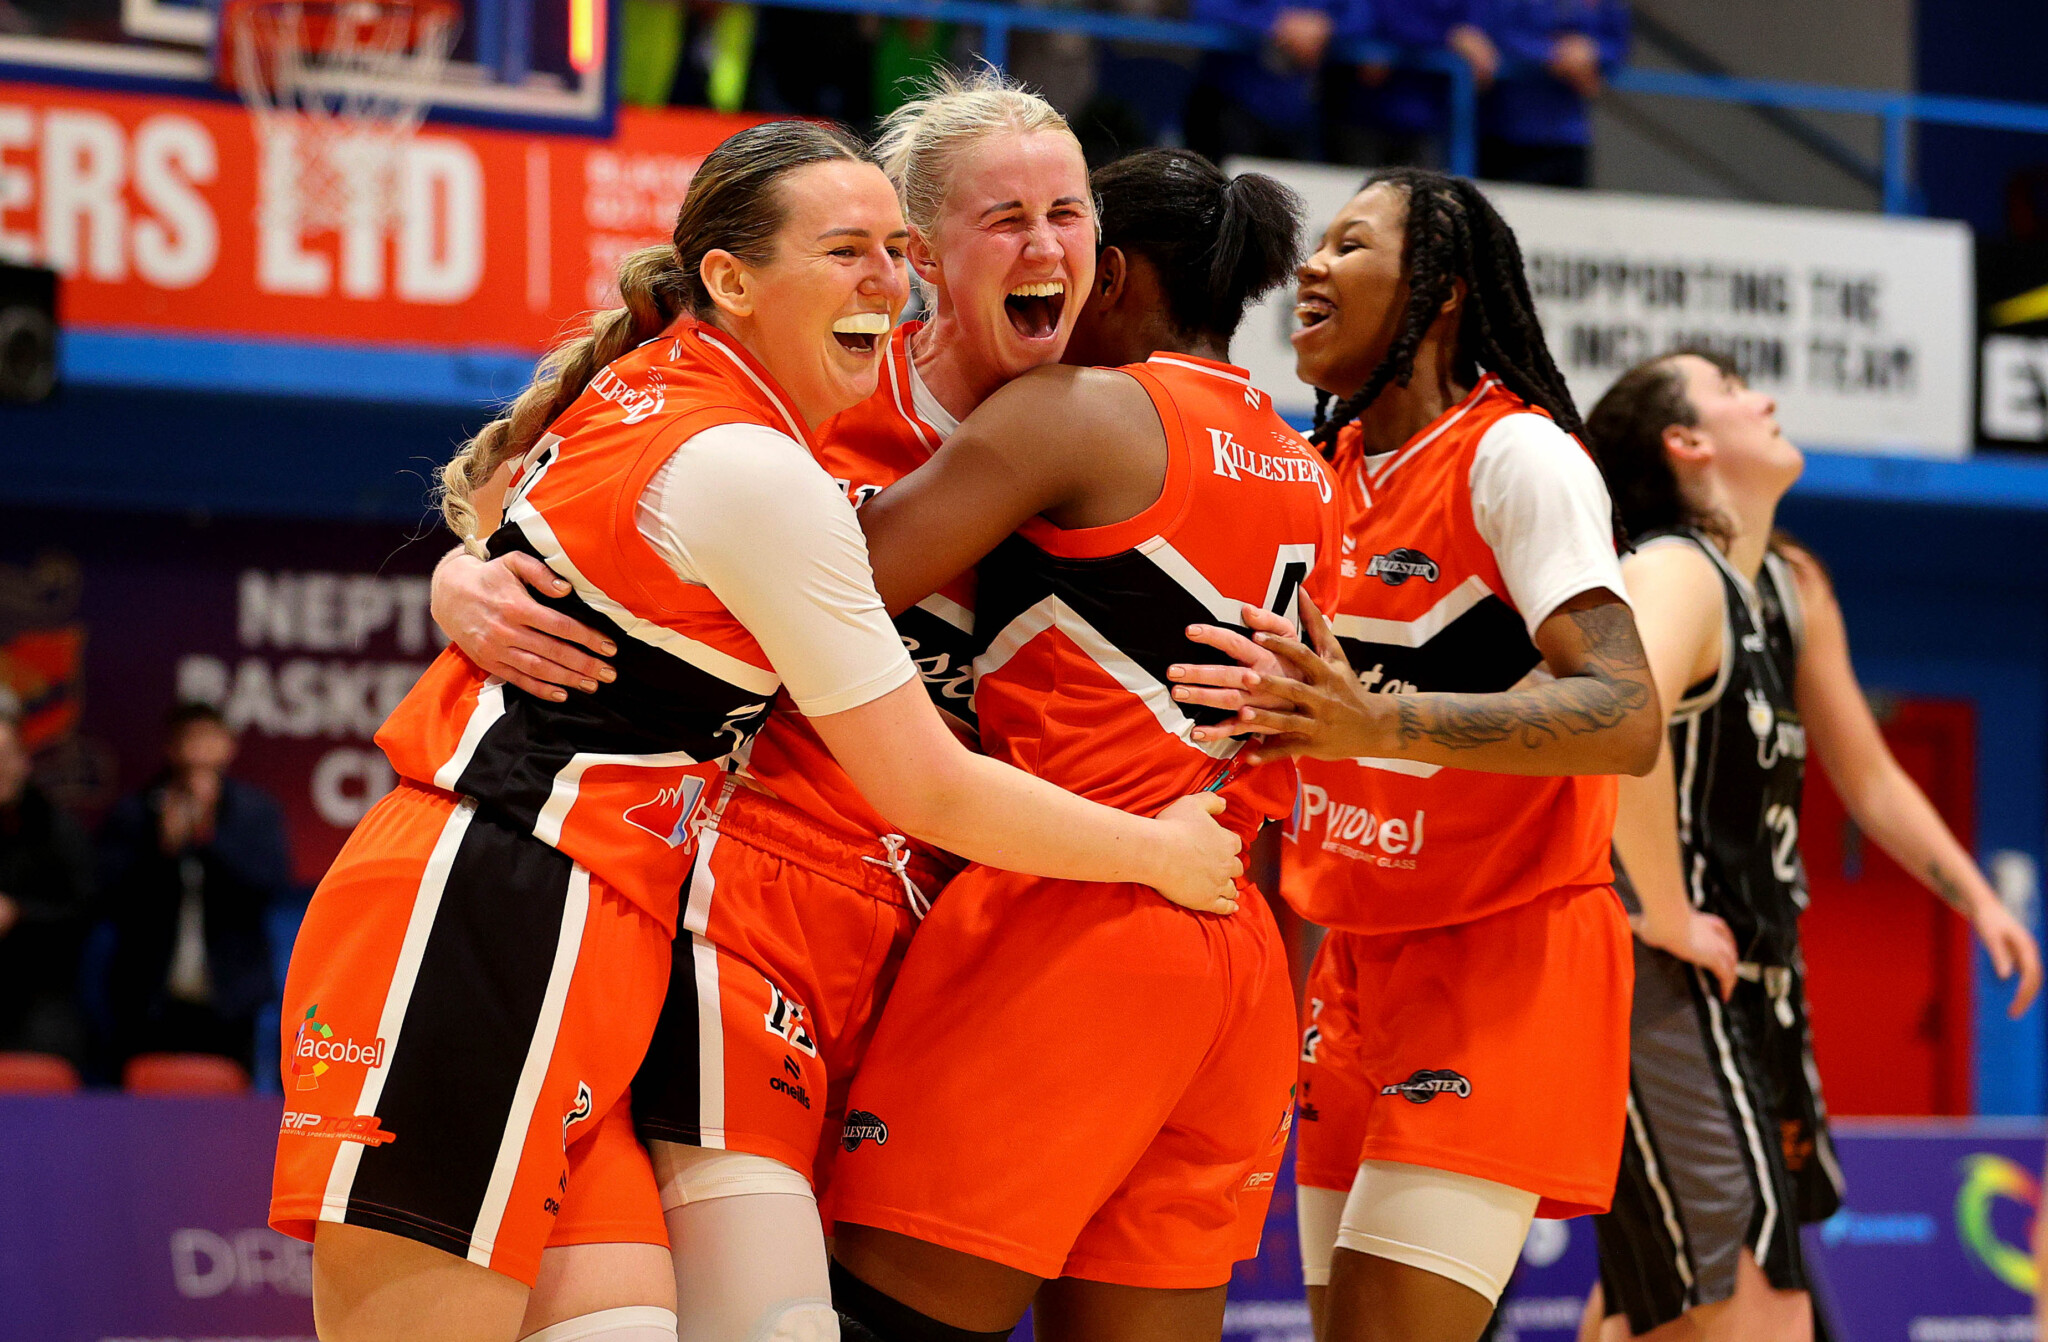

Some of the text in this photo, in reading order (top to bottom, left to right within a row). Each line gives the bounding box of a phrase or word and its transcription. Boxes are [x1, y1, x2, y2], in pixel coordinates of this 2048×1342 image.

[256, 130, 487, 303] LTD
[1809, 269, 1882, 328] THE
[1807, 336, 1916, 393] TEAM
[1206, 427, 1332, 504] KILLESTER
[237, 570, 456, 652] NEPT
